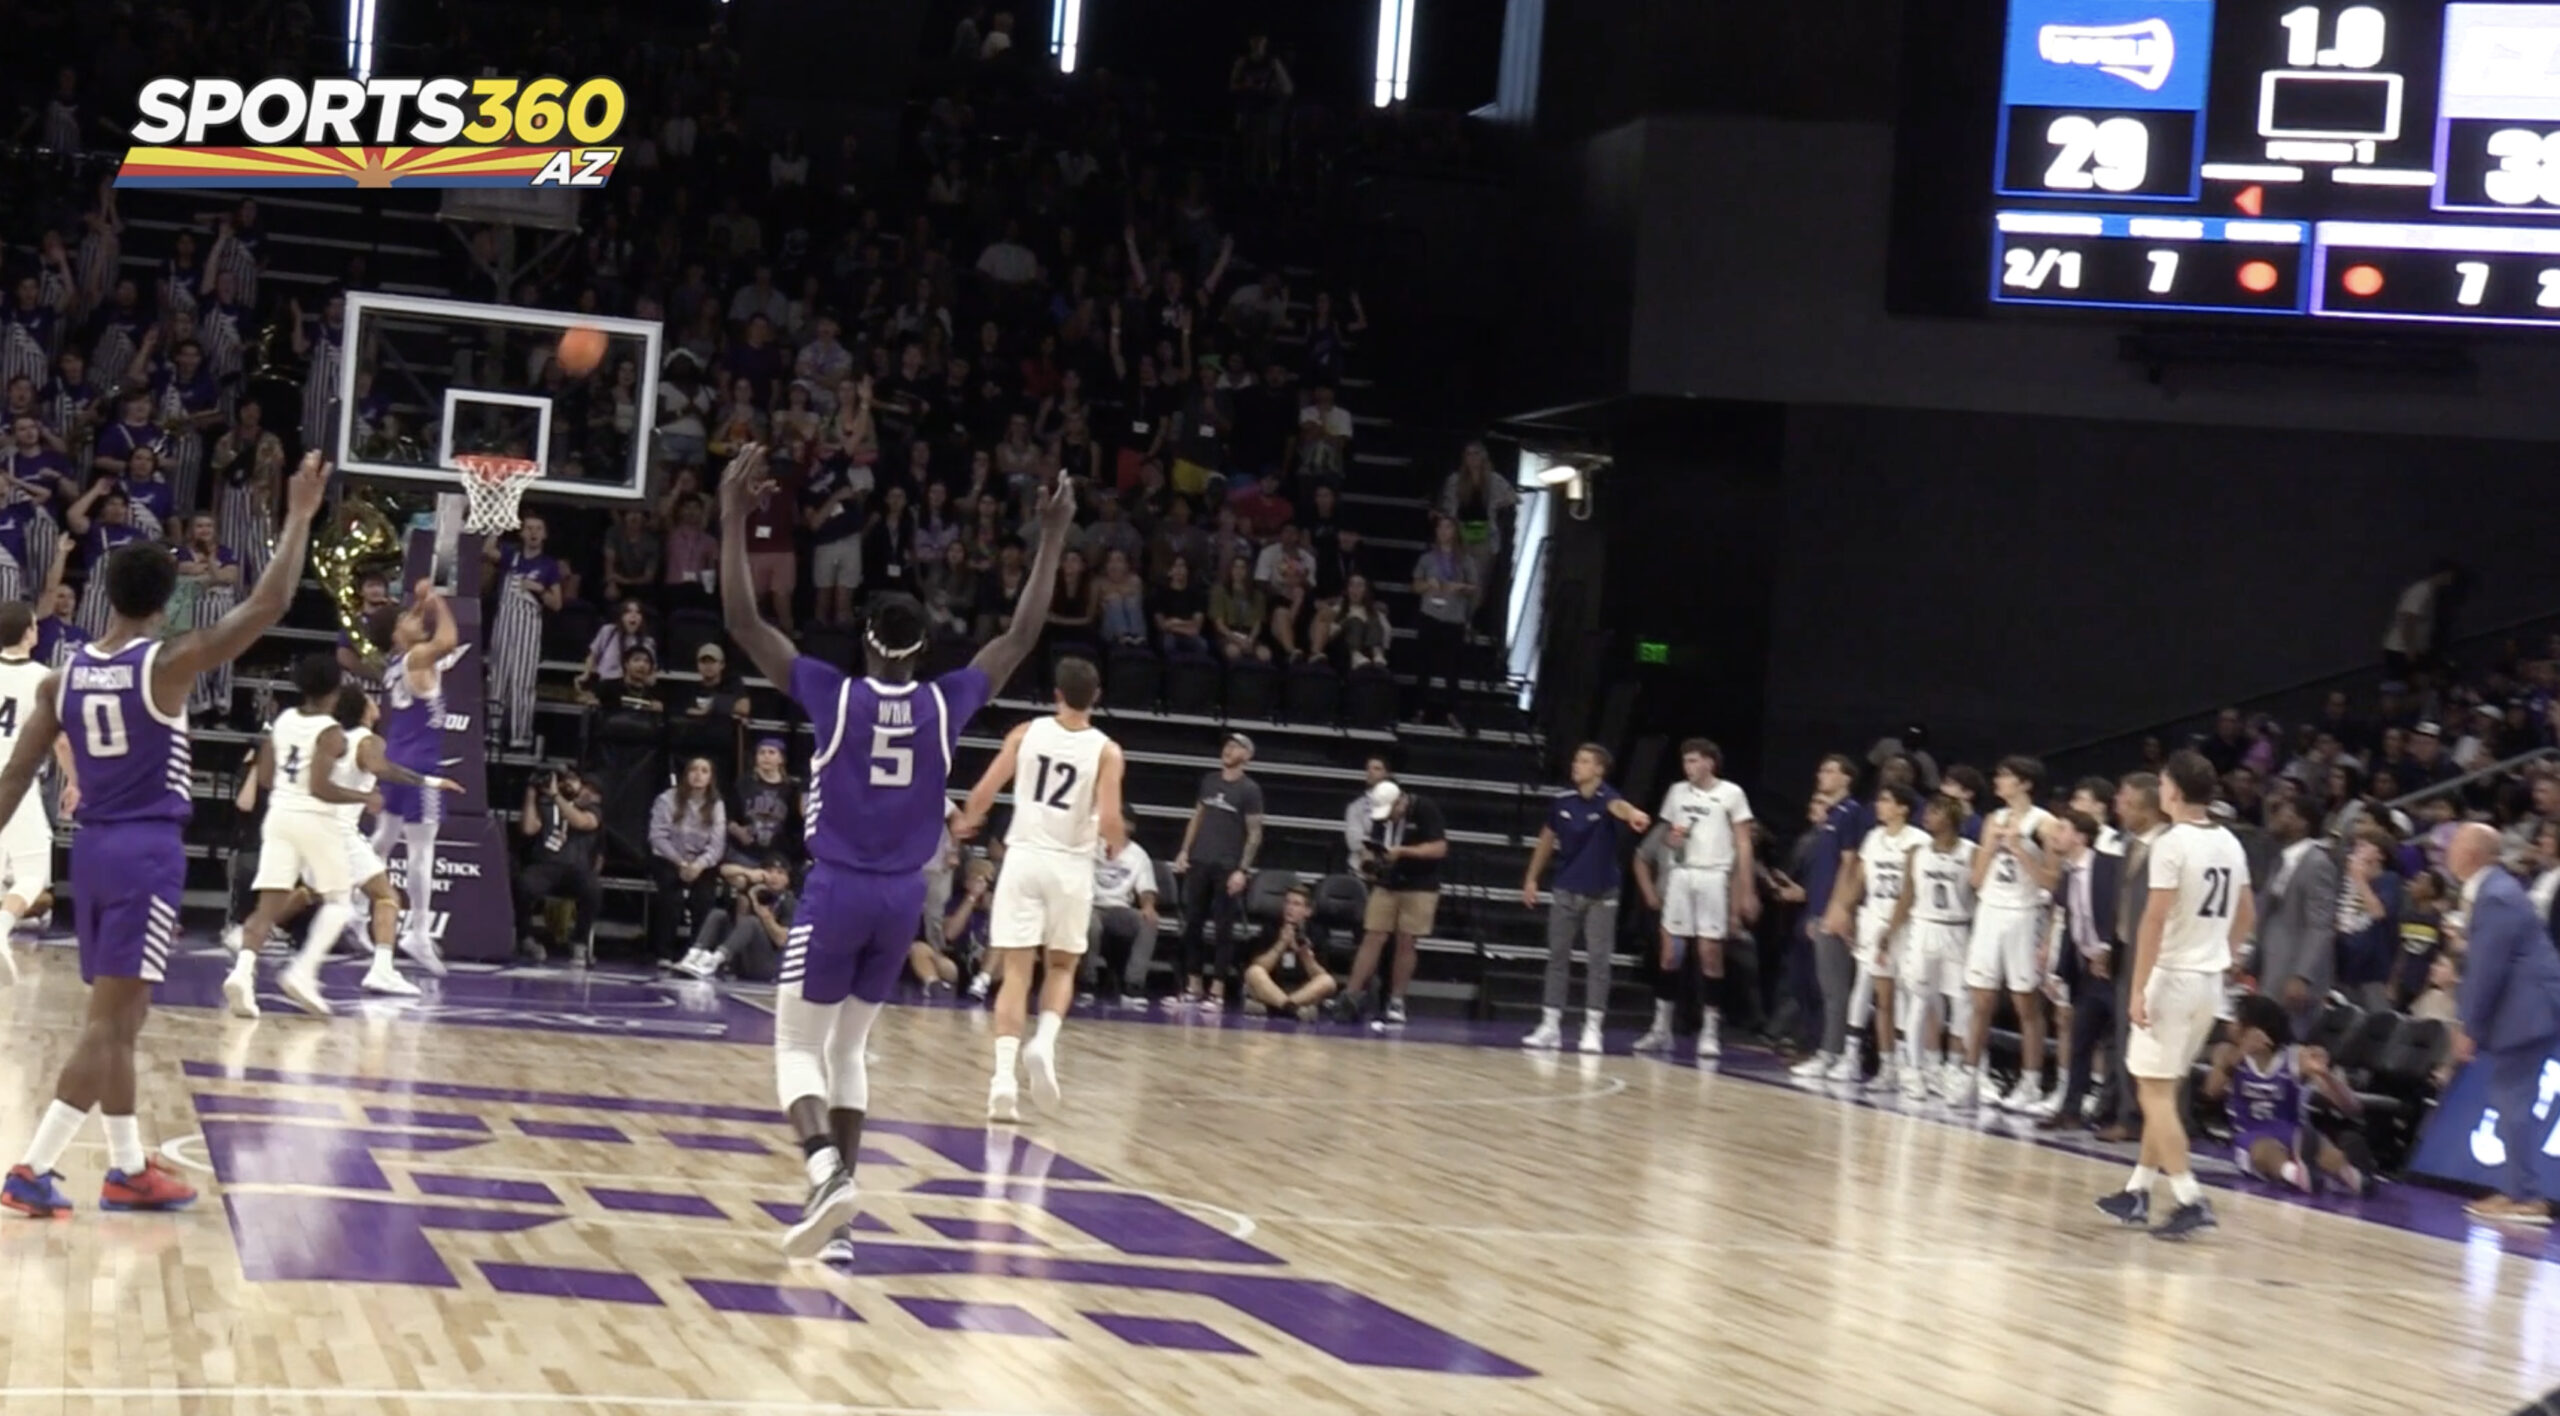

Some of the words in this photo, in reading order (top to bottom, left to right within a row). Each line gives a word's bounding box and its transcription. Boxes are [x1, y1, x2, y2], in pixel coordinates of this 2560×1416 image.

[2044, 115, 2149, 190] 29
[2003, 248, 2082, 290] 2/1
[0, 696, 17, 737] 4
[82, 693, 129, 757] 0
[279, 744, 302, 784] 4
[869, 726, 917, 787] 5
[1033, 753, 1078, 811] 12
[2196, 866, 2232, 918] 21
